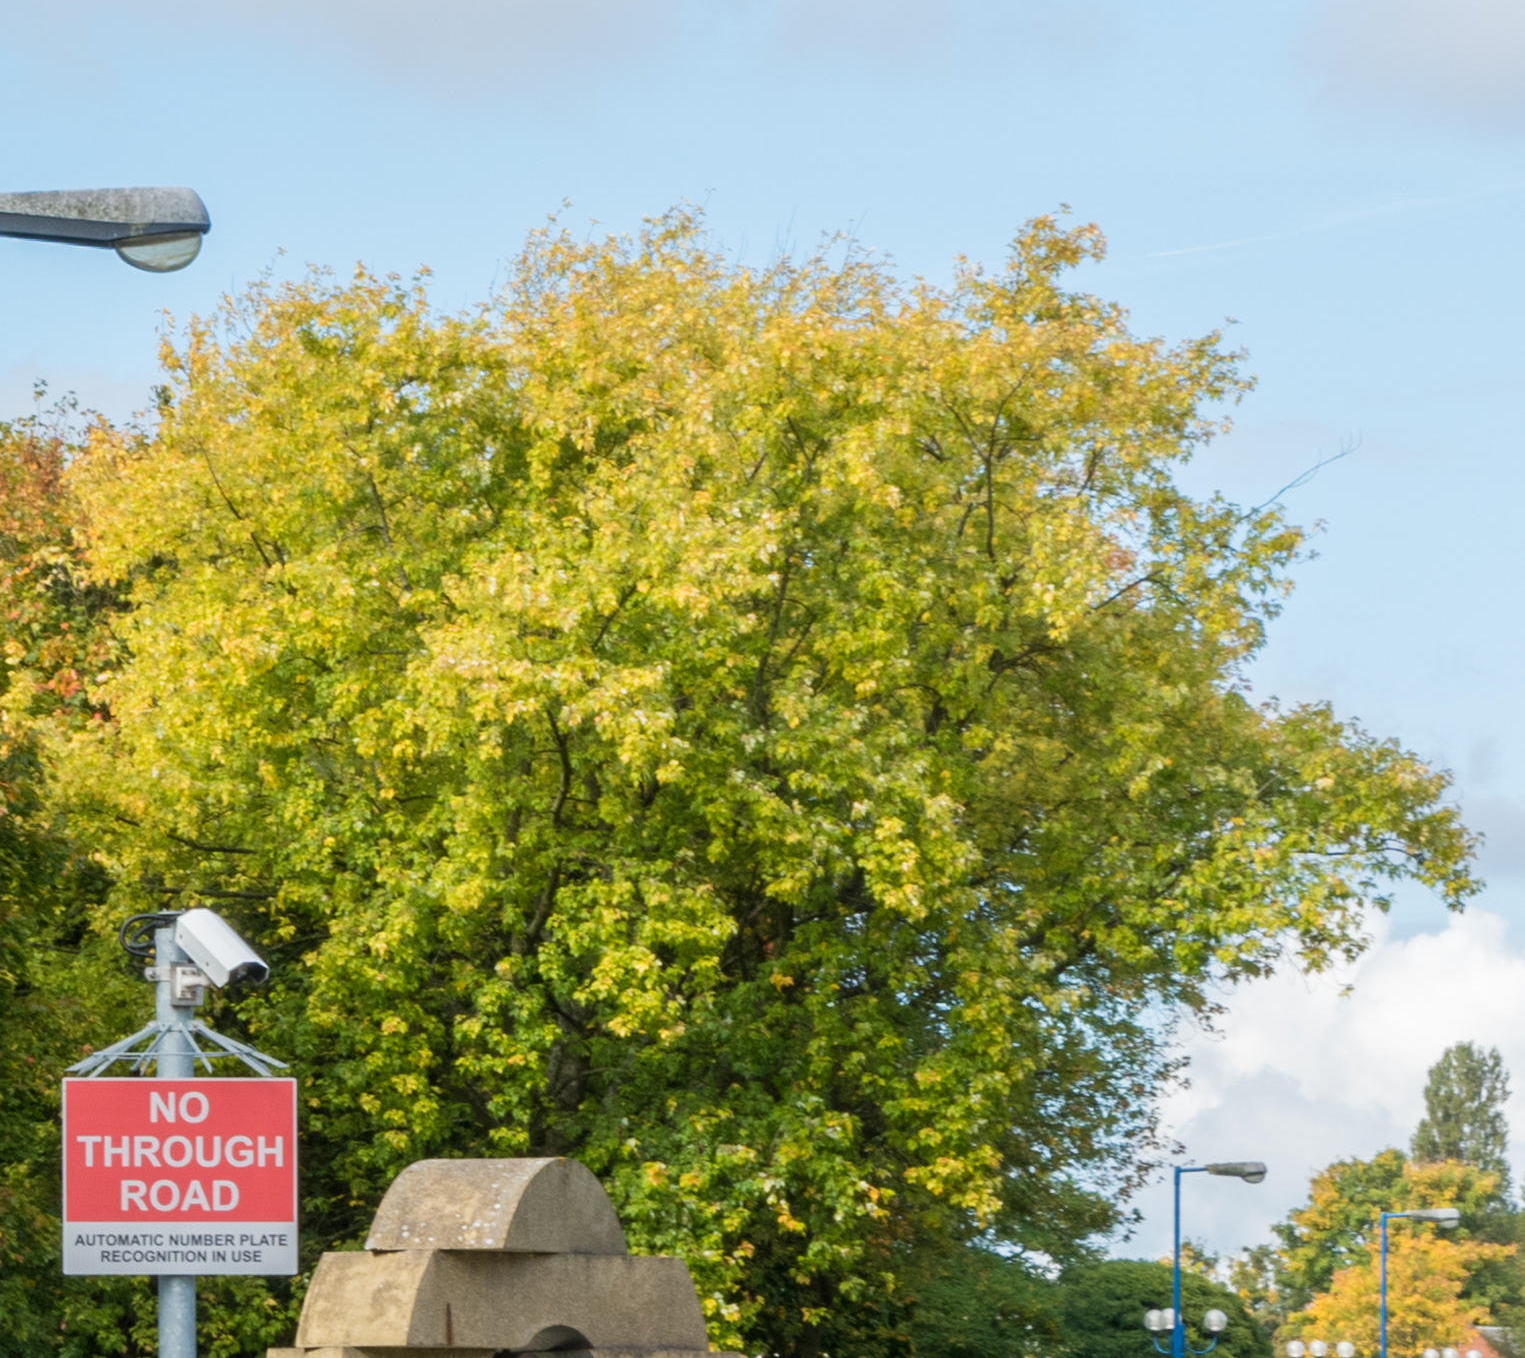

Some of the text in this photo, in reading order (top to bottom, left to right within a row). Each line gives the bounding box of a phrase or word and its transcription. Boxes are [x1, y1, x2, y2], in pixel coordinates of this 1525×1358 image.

[149, 1090, 211, 1124] NO
[76, 1134, 285, 1169] THROUGH
[120, 1178, 240, 1212] ROAD
[74, 1234, 288, 1247] AUTOMATIC NUMBER PLATE
[100, 1250, 263, 1263] RECOGNITION IN USE
